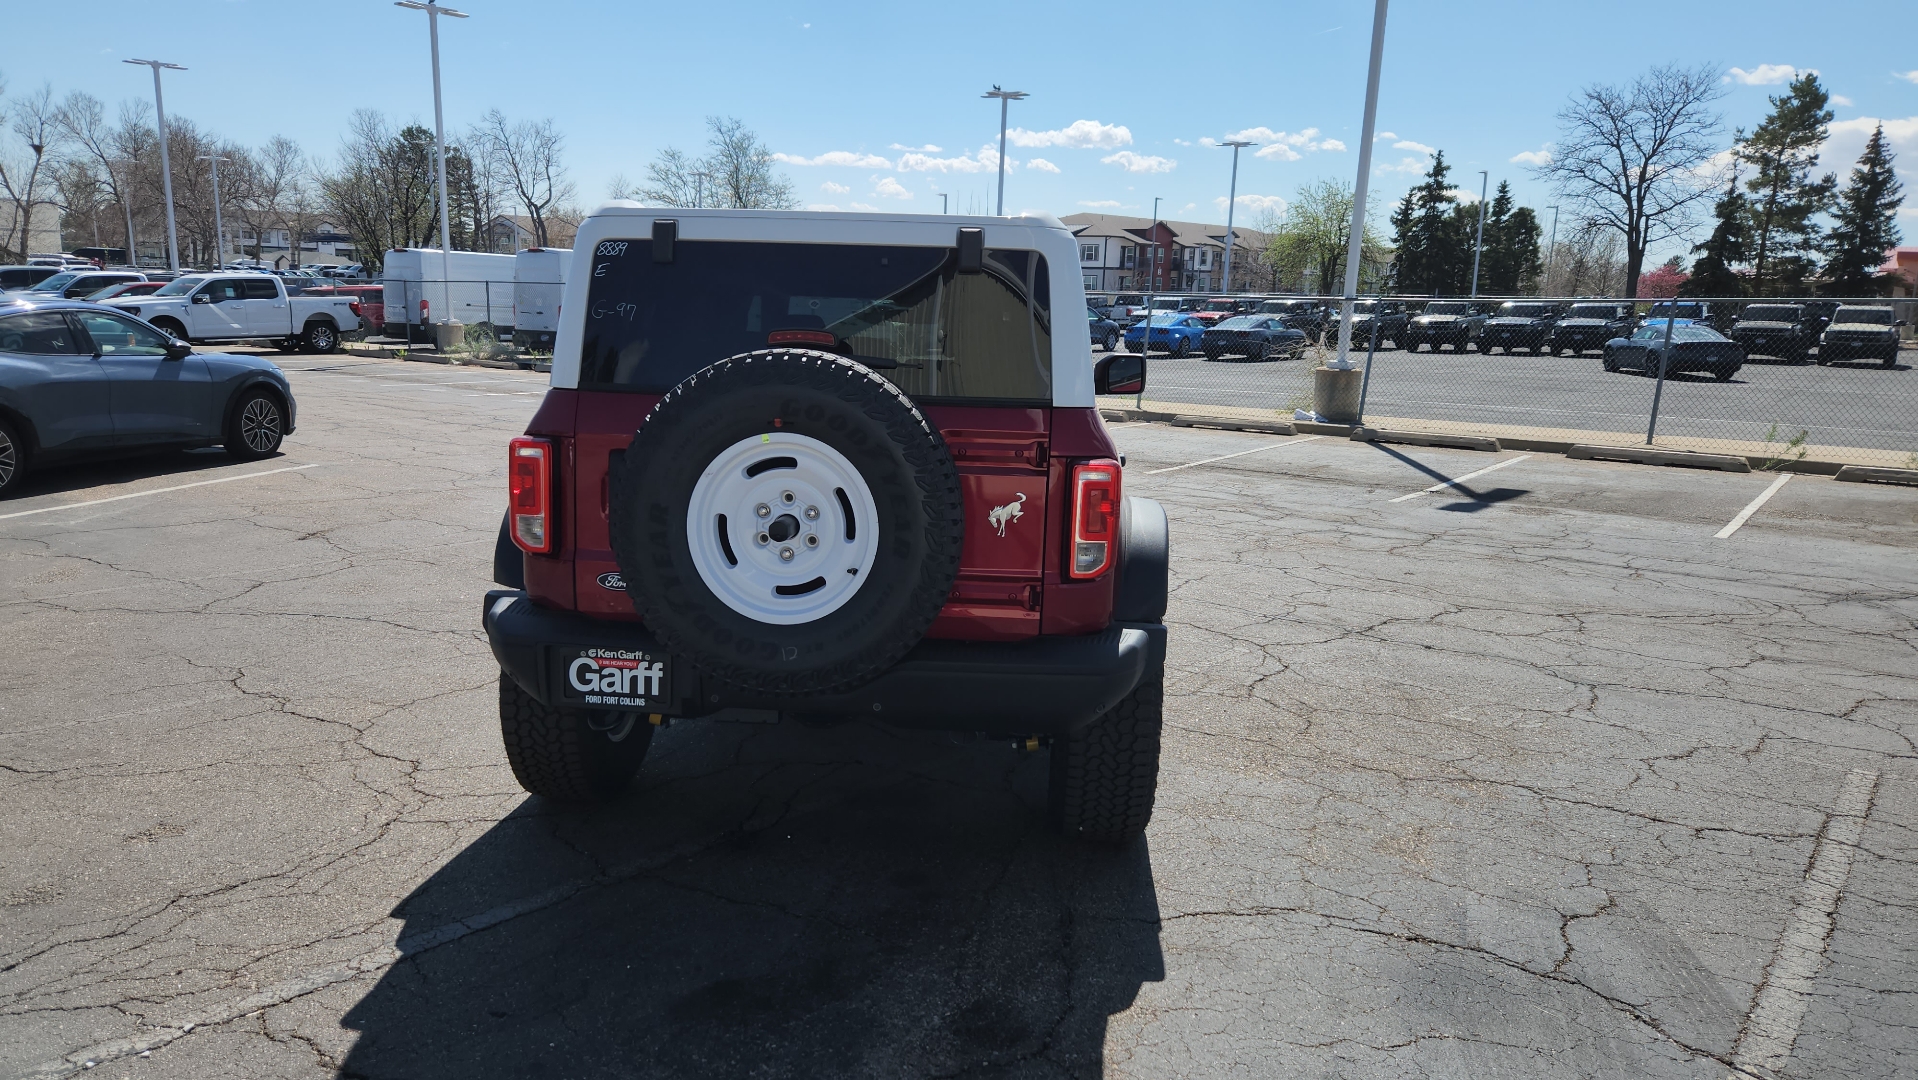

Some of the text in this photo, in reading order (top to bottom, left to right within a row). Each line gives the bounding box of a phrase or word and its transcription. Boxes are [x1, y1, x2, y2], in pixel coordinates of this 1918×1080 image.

[597, 241, 628, 257] 8889
[594, 262, 611, 277] E
[597, 649, 643, 660] Ken Garff
[568, 657, 664, 696] Garff
[585, 695, 645, 706] FORD FORT COLLINS
